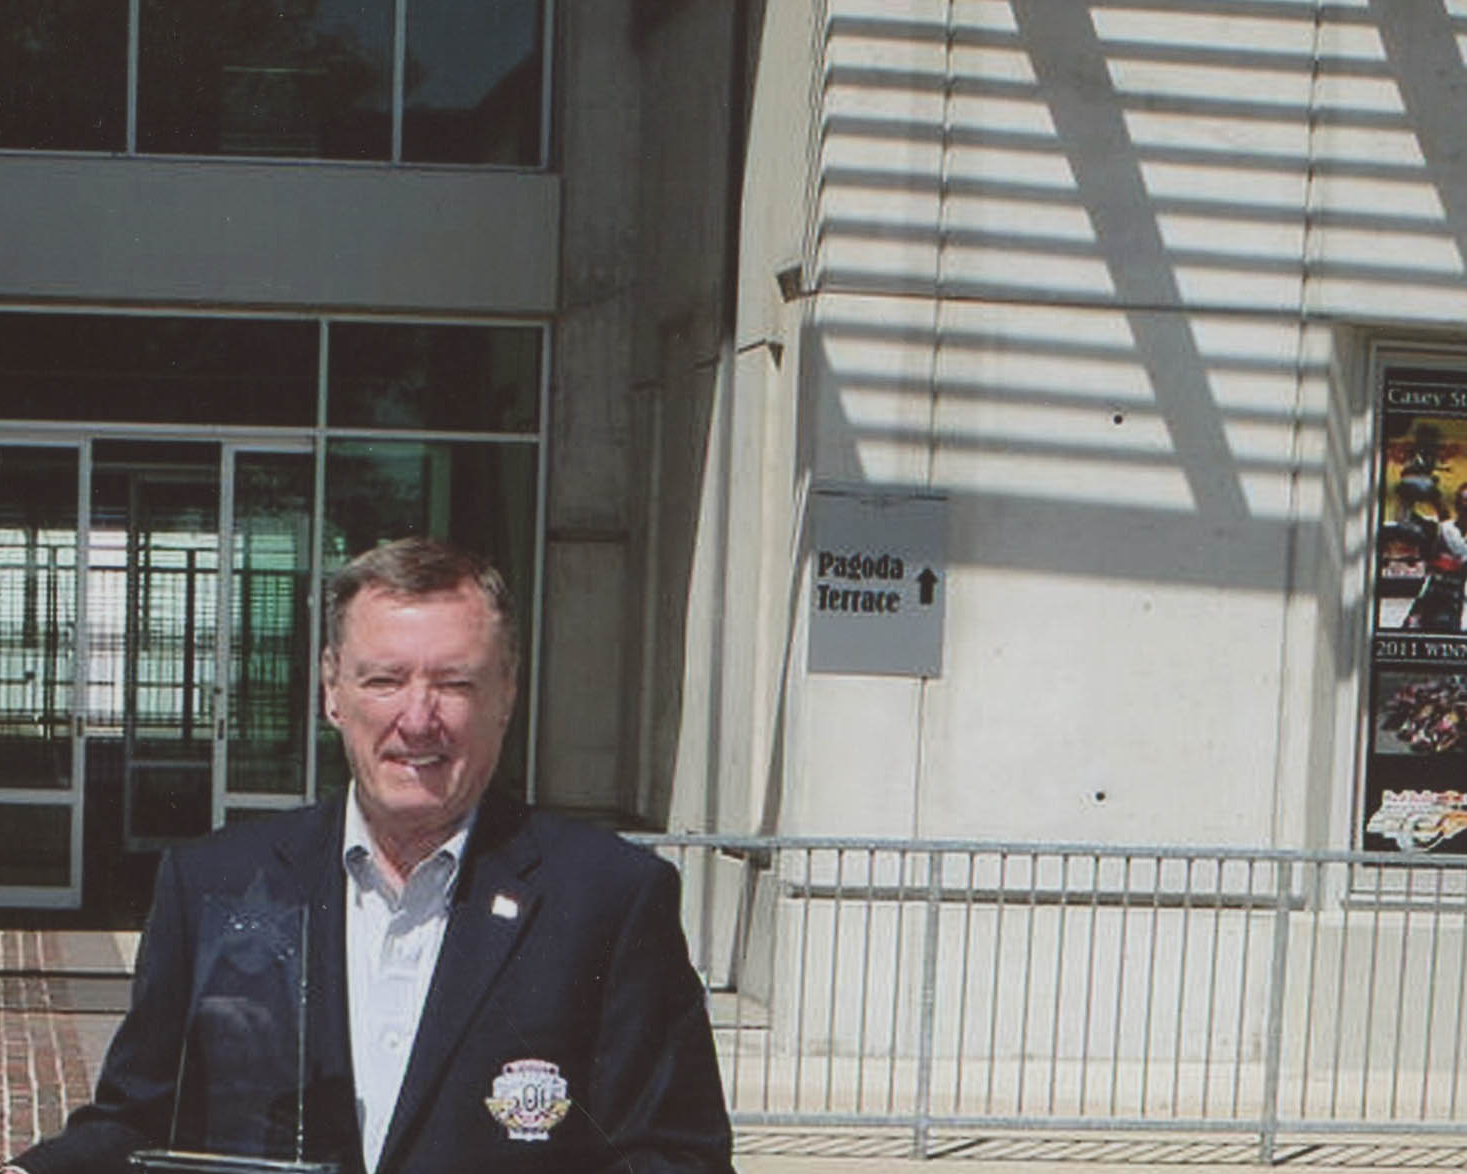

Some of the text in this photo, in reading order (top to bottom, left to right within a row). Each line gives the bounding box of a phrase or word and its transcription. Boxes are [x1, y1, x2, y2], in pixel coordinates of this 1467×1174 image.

[1388, 388, 1440, 408] Casey
[817, 551, 904, 581] Pagoda
[817, 584, 901, 613] Terrace
[1375, 640, 1418, 657] 2011
